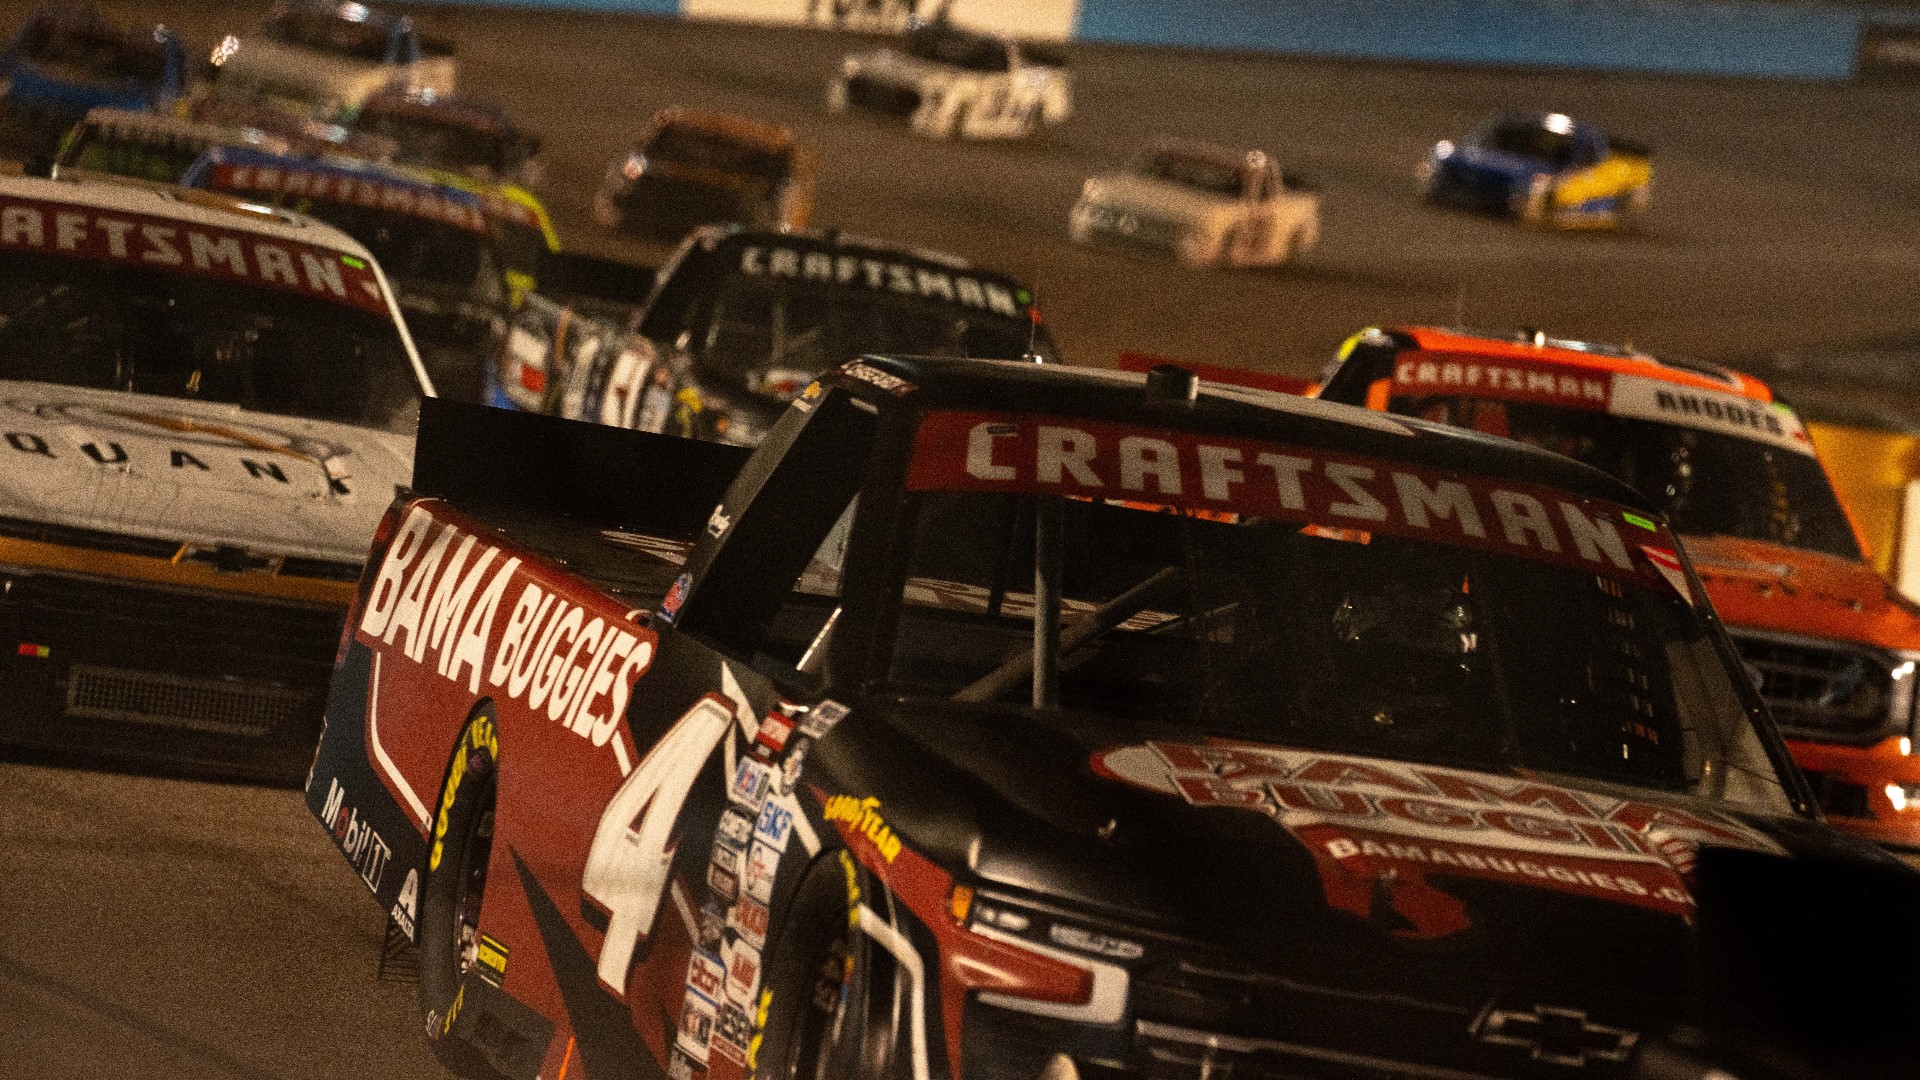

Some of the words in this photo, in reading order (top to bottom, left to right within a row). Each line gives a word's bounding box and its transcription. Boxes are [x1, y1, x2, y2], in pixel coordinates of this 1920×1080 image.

[740, 247, 1017, 317] CRAFTSMAN
[1397, 361, 1606, 401] CRAFTSMAN
[1655, 389, 1785, 437] RHODES
[965, 420, 1636, 572] CRAFTSMAN
[360, 505, 520, 695] BAMA
[489, 582, 653, 748] BUGGIES
[321, 776, 372, 863] Mobil
[582, 697, 733, 996] 4
[757, 801, 793, 841] SKF
